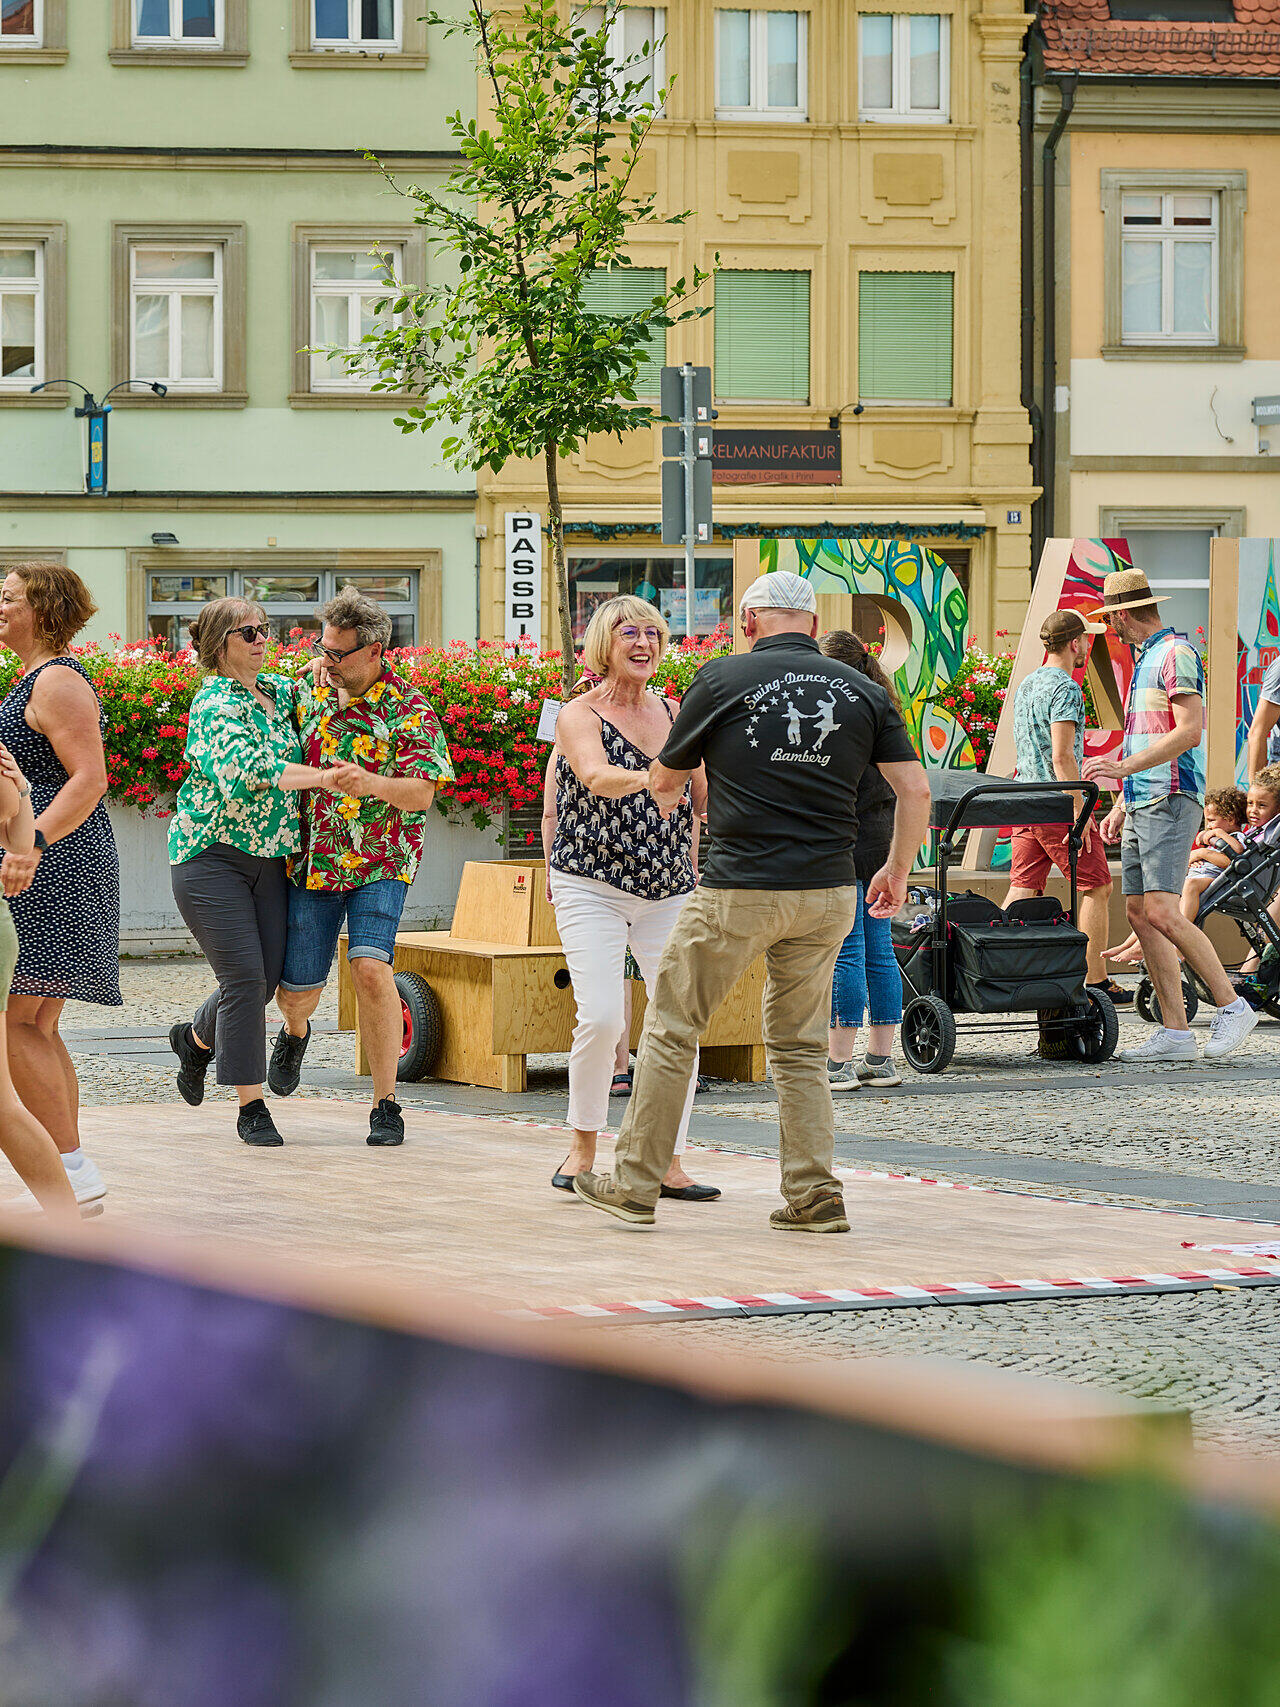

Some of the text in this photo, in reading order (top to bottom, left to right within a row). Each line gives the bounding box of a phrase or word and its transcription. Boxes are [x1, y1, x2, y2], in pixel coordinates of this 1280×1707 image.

[1256, 403, 1280, 417] WOOLWORT
[713, 472, 756, 481] Fotografie
[764, 471, 789, 480] Grafik
[796, 471, 814, 480] Print
[744, 671, 859, 711] Swing-Dance-Club
[770, 748, 831, 767] Bamberg
